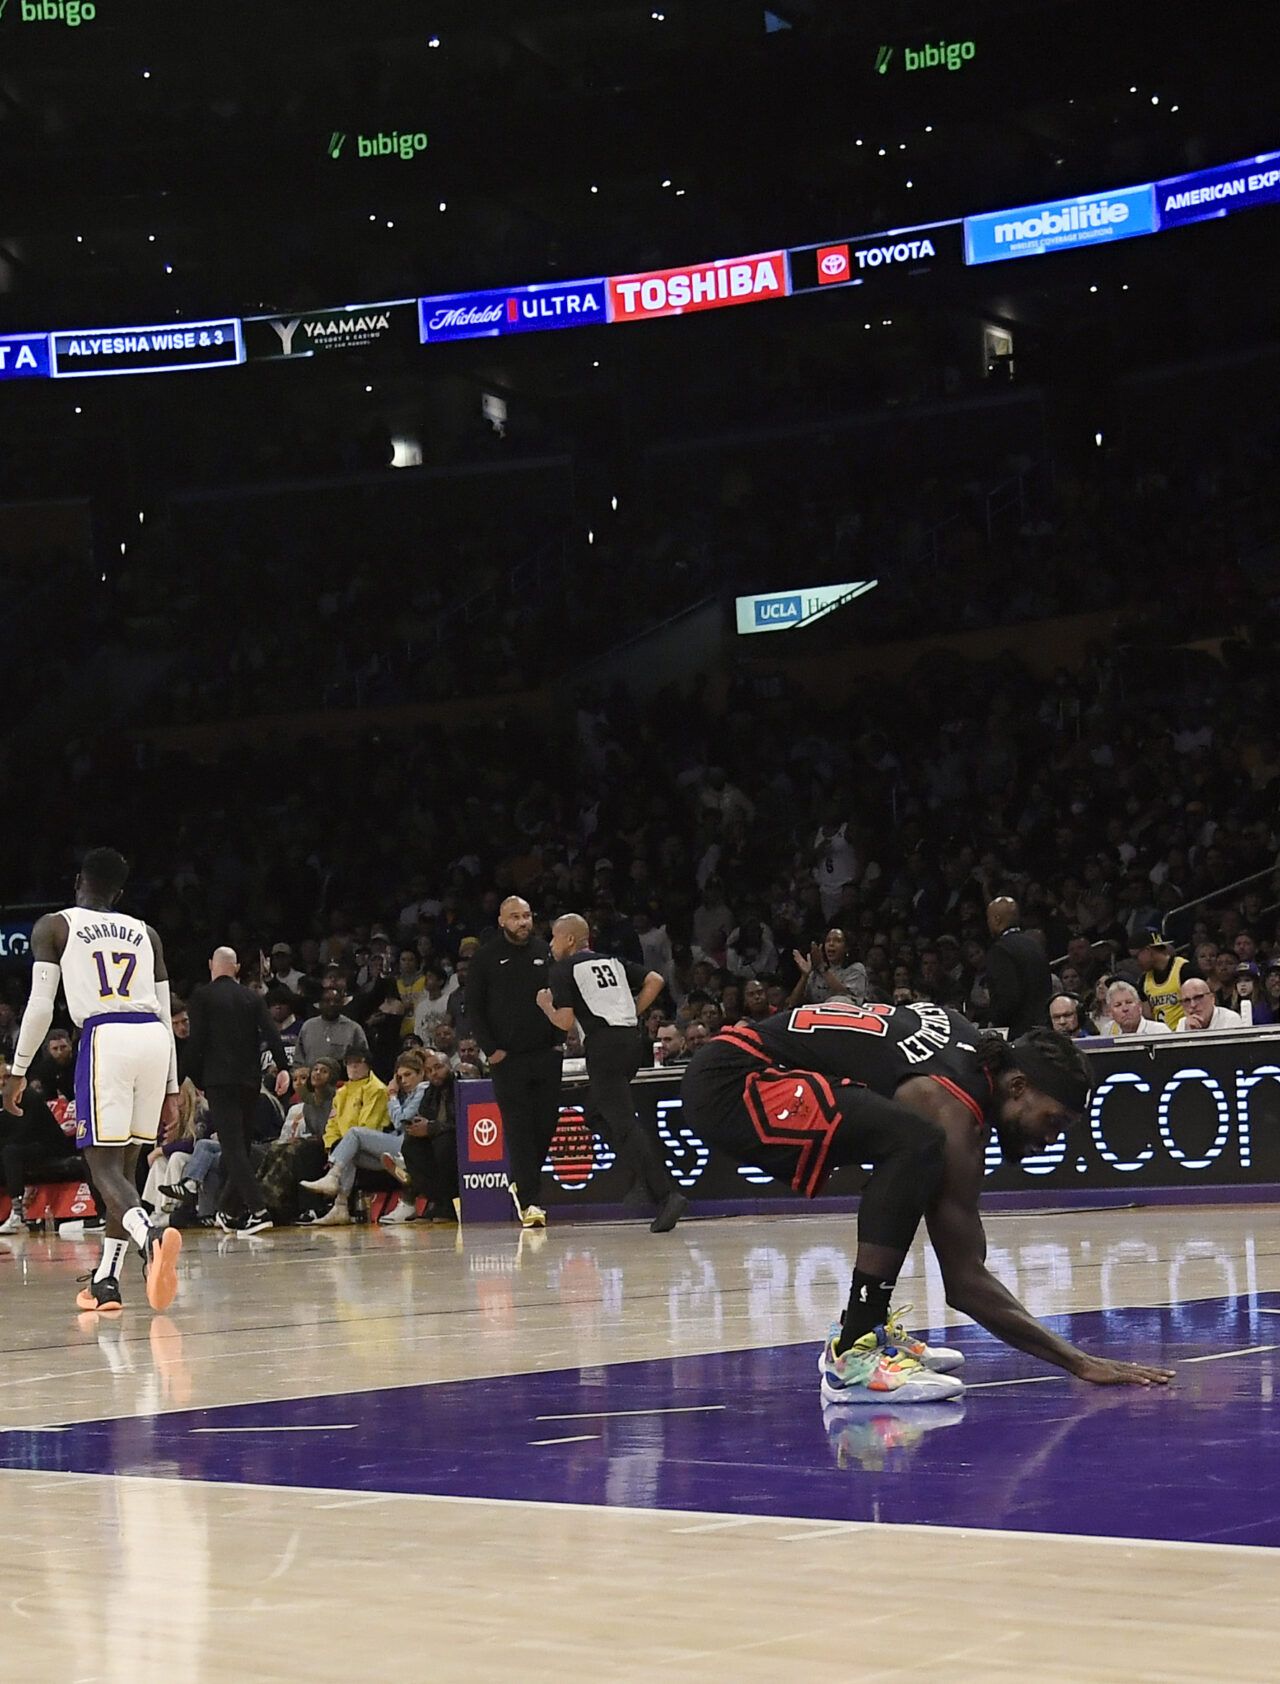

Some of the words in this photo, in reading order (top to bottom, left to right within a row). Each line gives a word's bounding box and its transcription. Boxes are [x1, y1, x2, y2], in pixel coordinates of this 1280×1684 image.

[21, 0, 96, 26] bibigo
[905, 41, 976, 71] bibigo
[358, 131, 428, 159] bibigo
[1164, 178, 1245, 211] AMERICAN
[994, 200, 1129, 244] mobilitie
[855, 239, 936, 269] TOYOTA
[616, 261, 779, 313] TOSHIBA
[429, 303, 504, 330] Michelob
[522, 293, 600, 319] ULTRA
[68, 338, 150, 356] ALYESHA
[151, 333, 195, 350] WISE
[198, 331, 211, 346] &
[213, 331, 224, 345] 3
[760, 602, 798, 620] UCLA
[76, 922, 144, 947] SCHRÖDER
[92, 951, 138, 1001] 17
[591, 965, 618, 989] 33
[463, 1173, 509, 1189] TOYOTA
